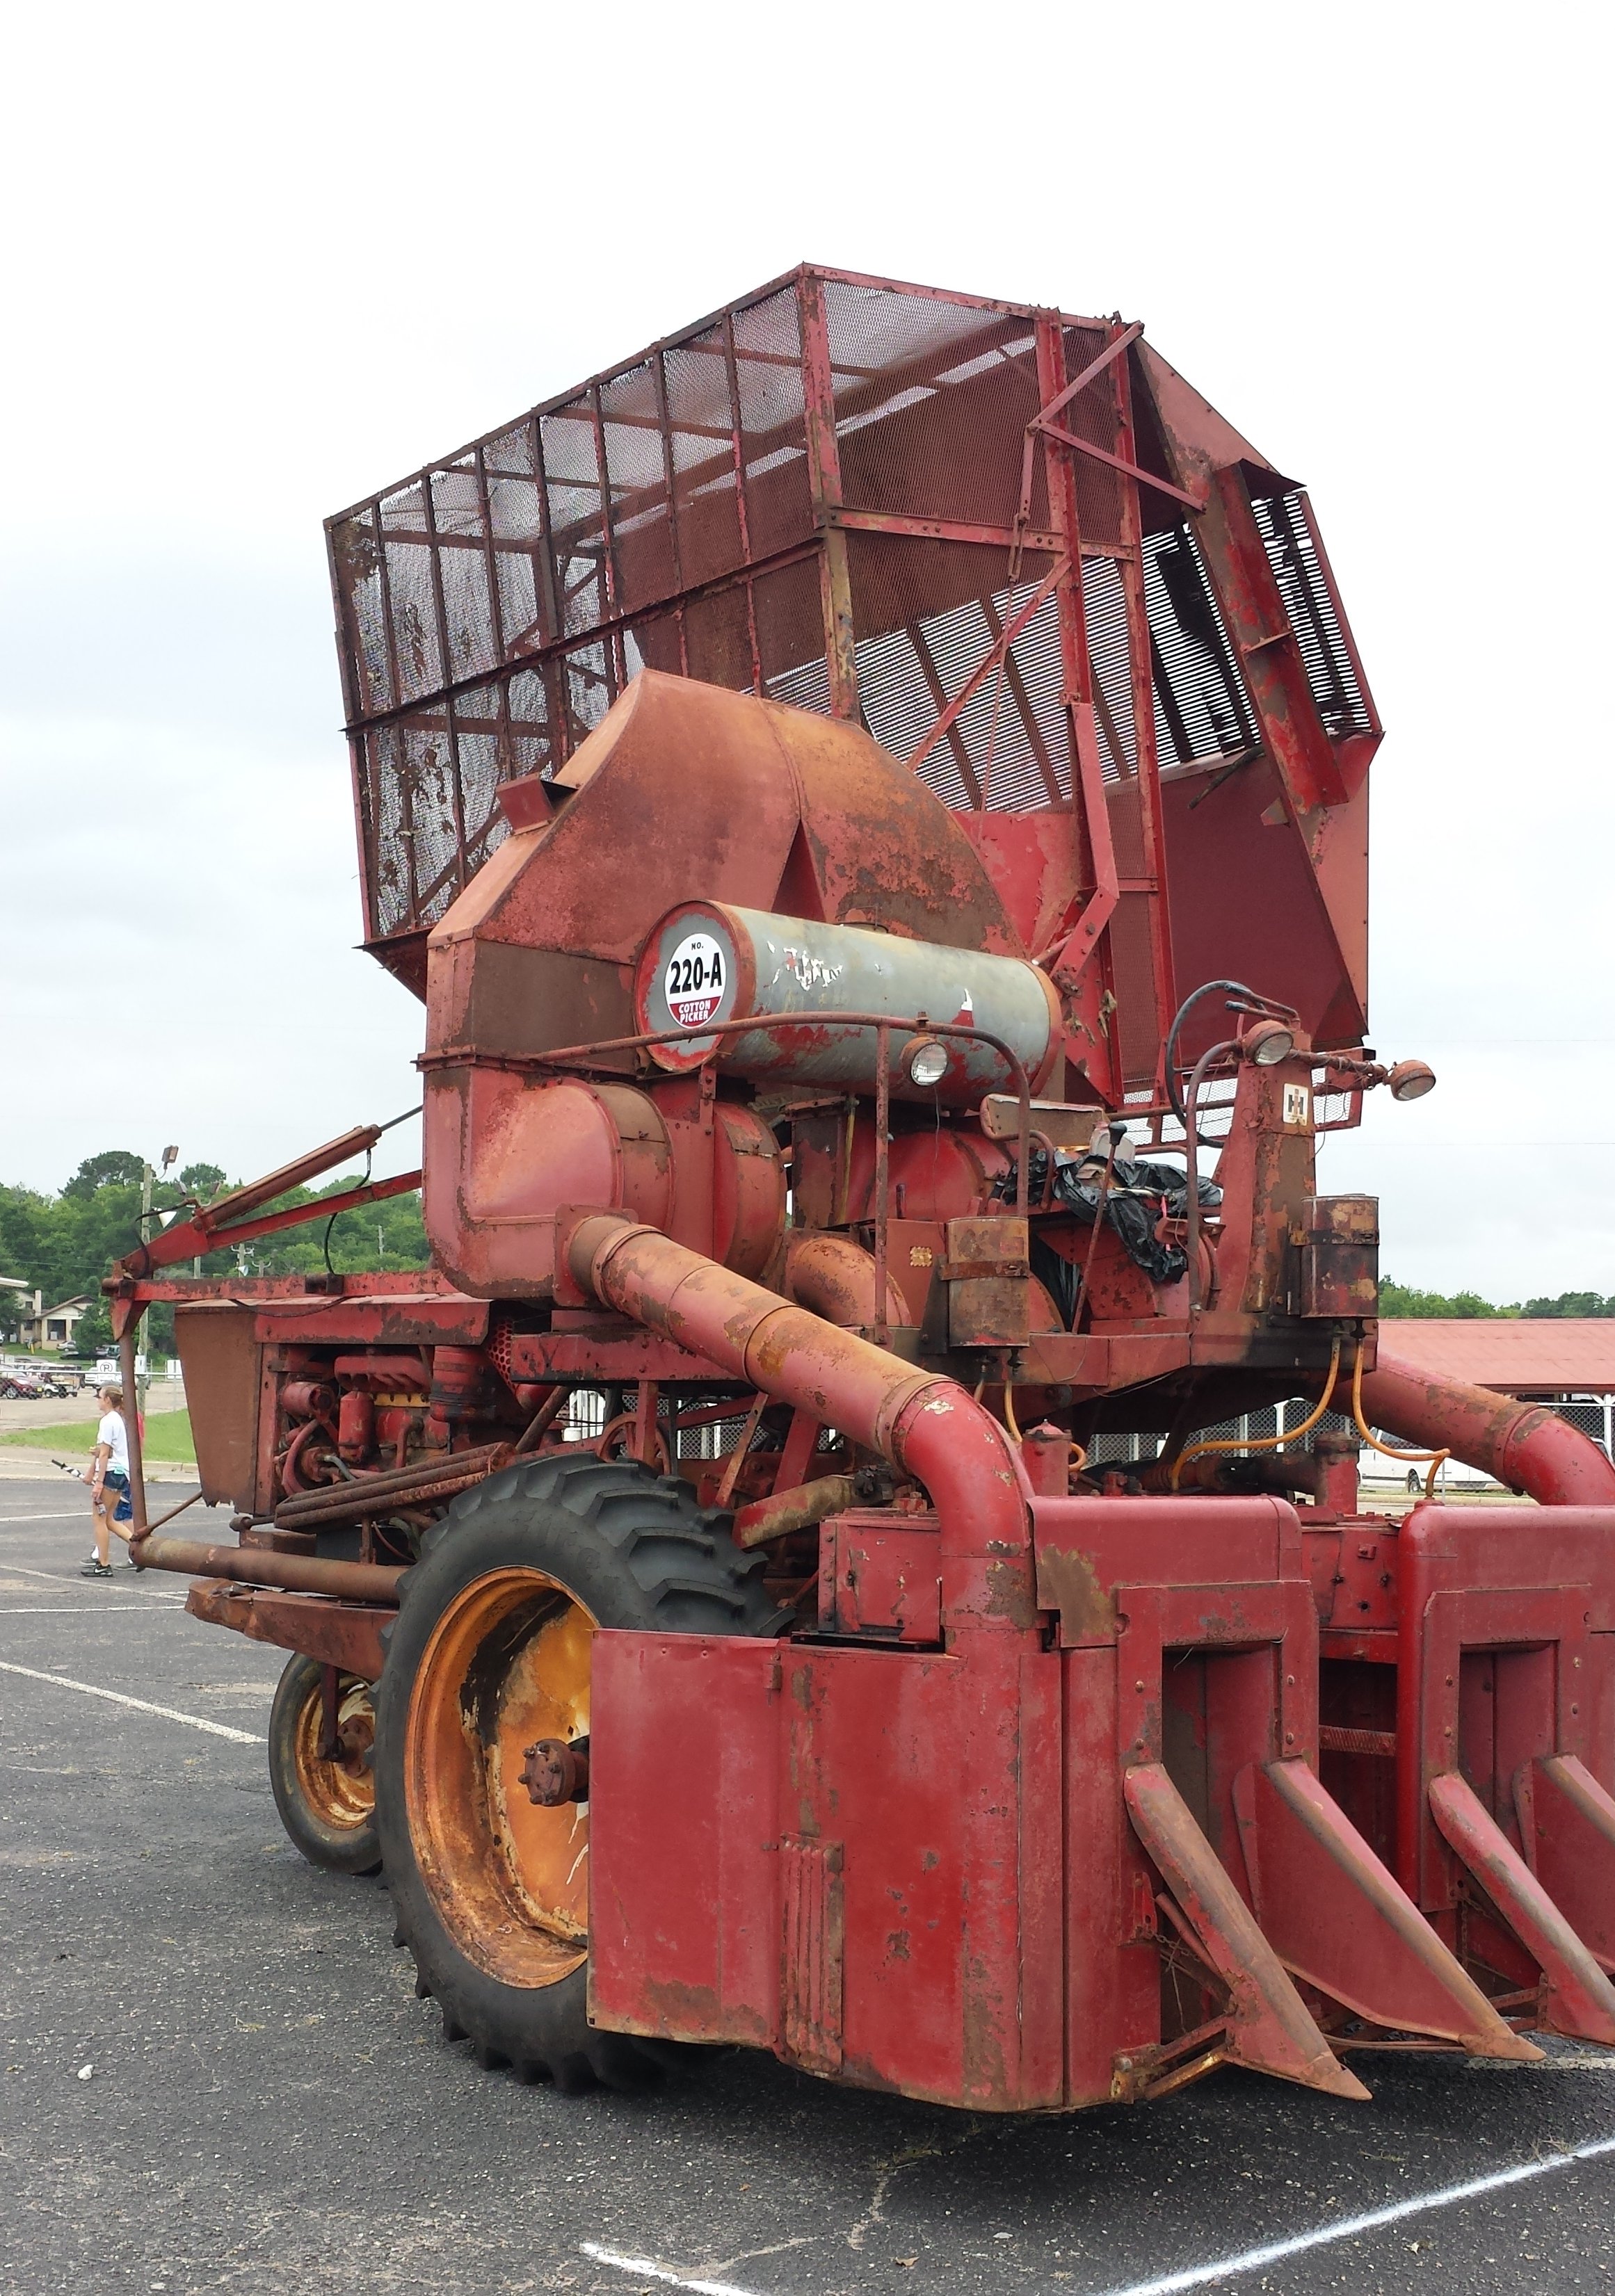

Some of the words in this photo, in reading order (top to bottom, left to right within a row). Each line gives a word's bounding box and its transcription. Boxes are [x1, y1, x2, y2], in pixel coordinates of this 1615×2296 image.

[691, 941, 704, 951] NO.
[670, 952, 722, 995] 220-A
[678, 999, 711, 1014] COTTON
[680, 1010, 709, 1024] PICKER
